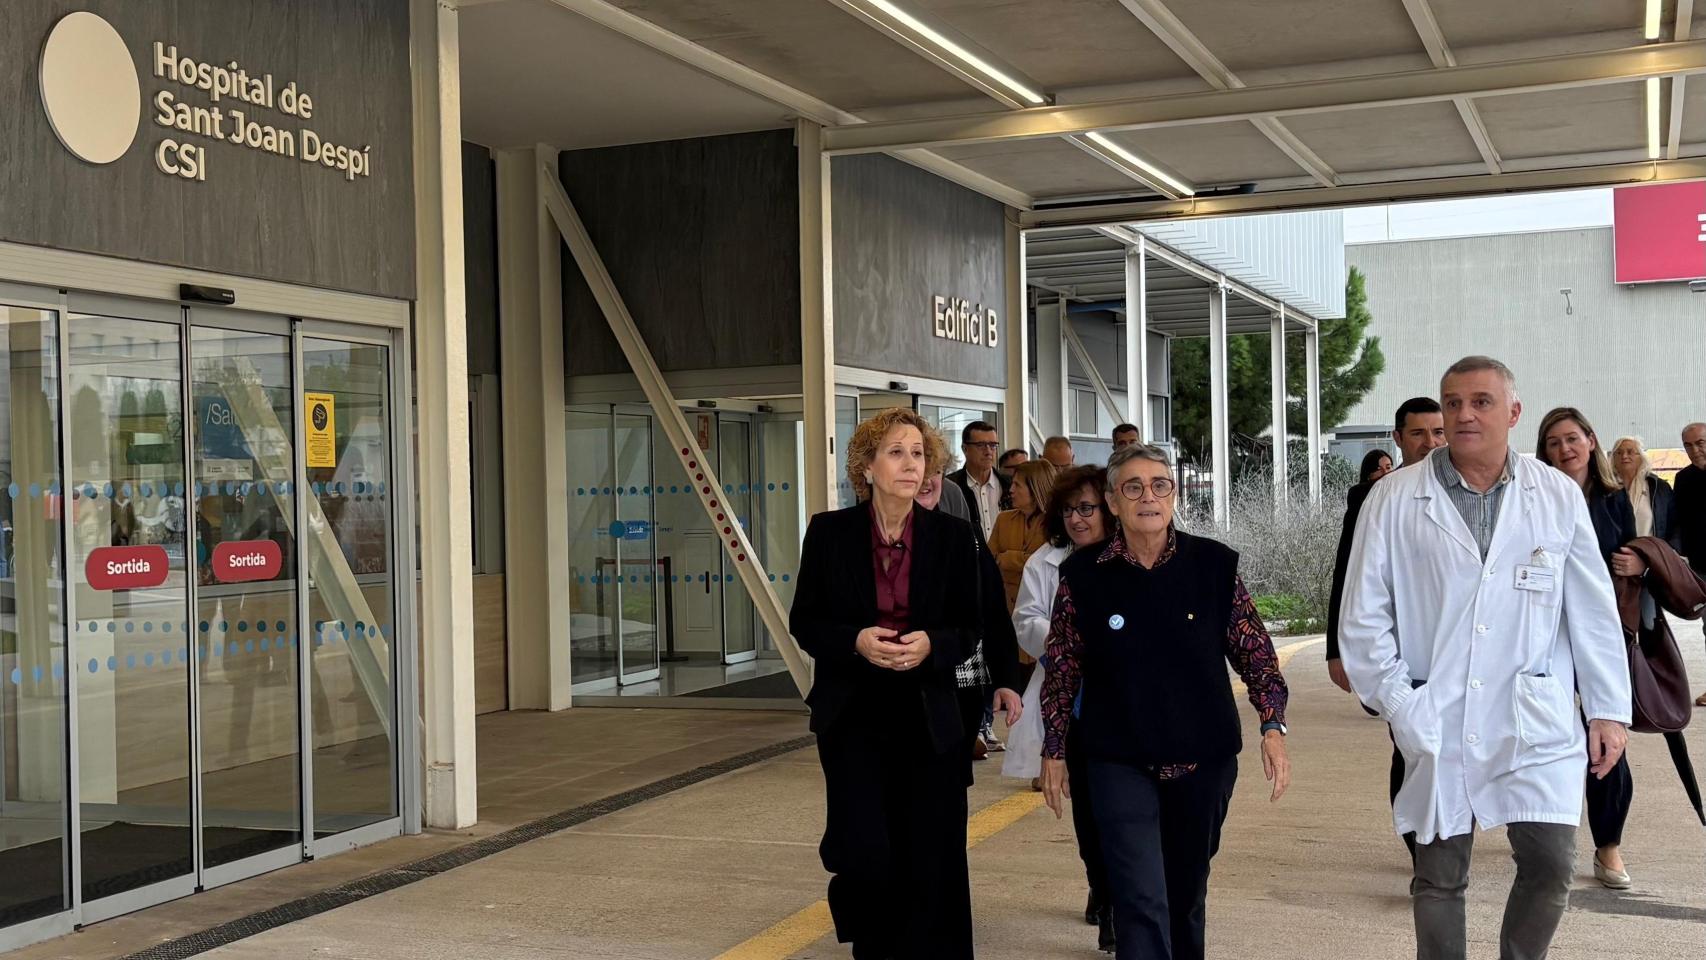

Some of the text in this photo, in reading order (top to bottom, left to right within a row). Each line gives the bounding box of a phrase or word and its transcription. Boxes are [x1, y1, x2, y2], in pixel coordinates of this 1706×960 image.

[153, 41, 313, 119] Hospital de
[154, 90, 371, 181] Sant Joan Despí
[155, 138, 206, 181] CSI
[934, 294, 998, 348] Edifici B
[106, 559, 151, 575] Sortida
[229, 552, 266, 568] Sortida
